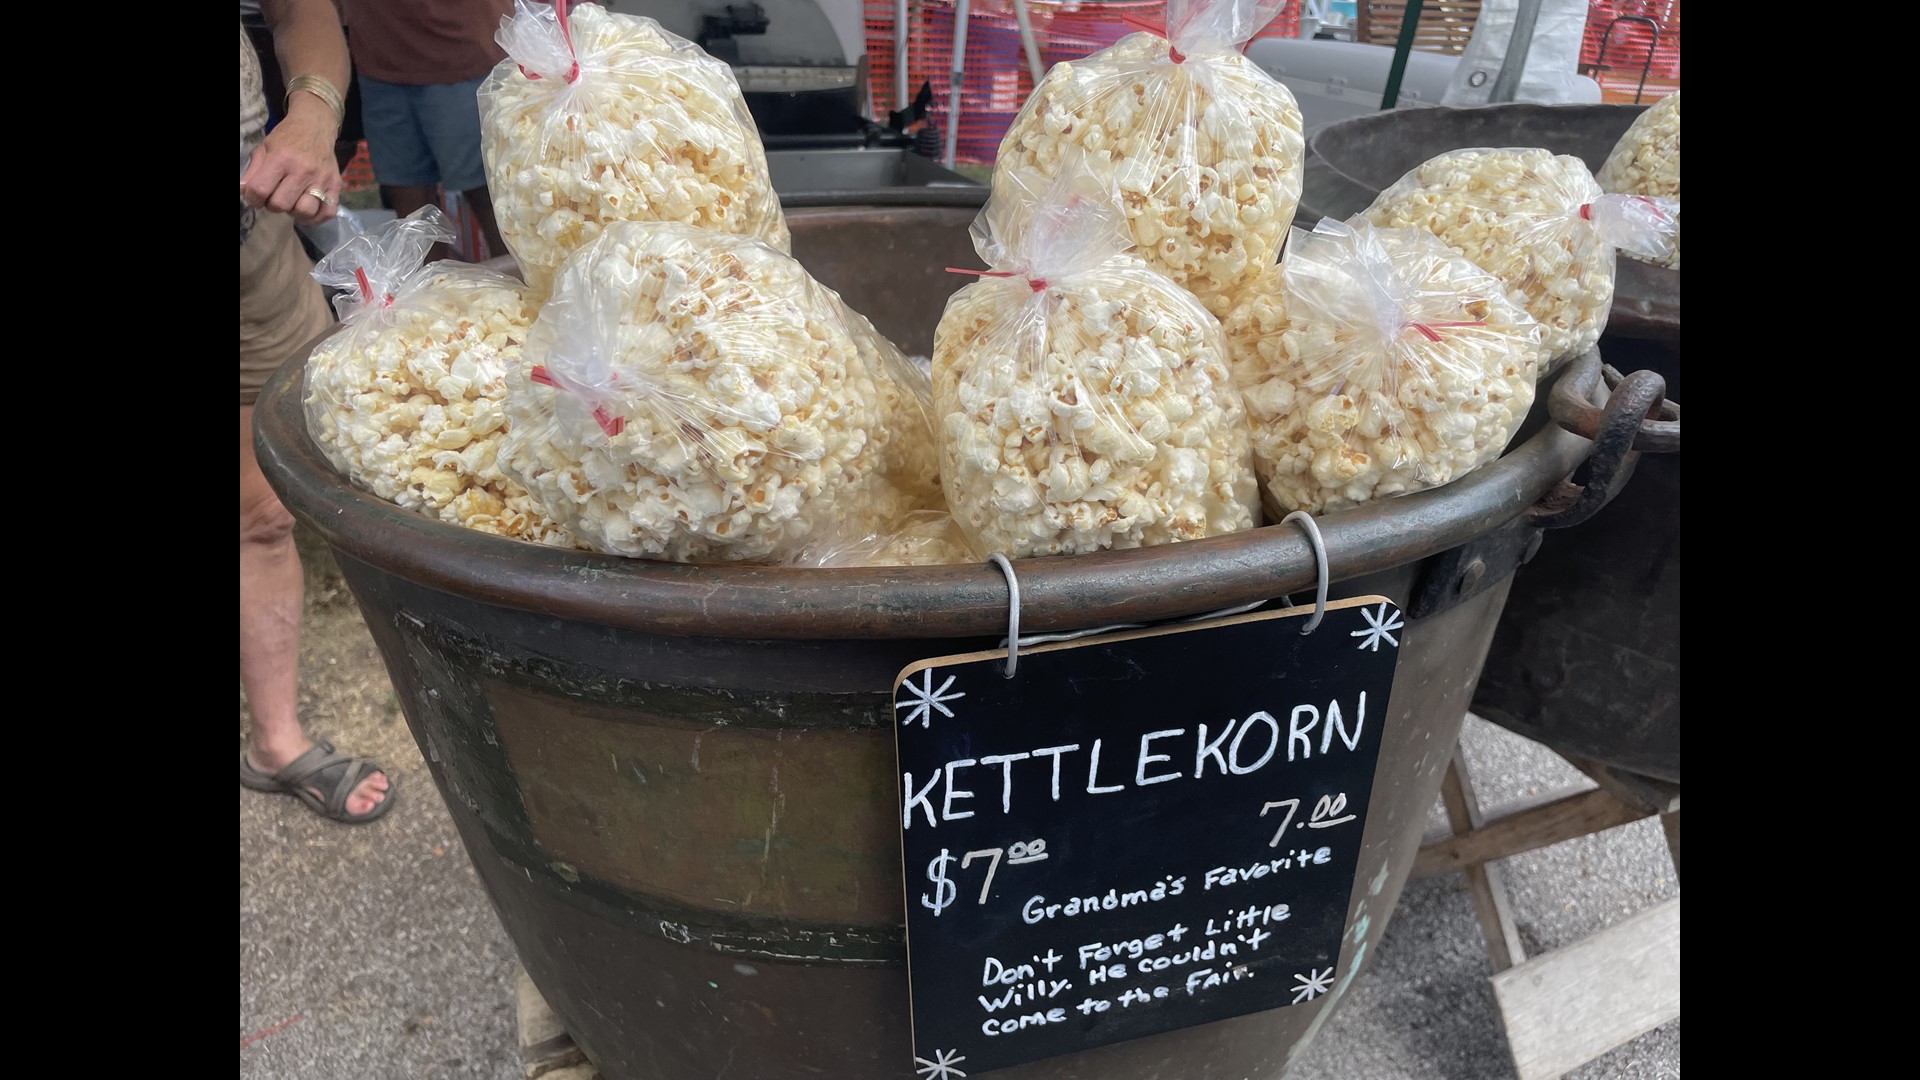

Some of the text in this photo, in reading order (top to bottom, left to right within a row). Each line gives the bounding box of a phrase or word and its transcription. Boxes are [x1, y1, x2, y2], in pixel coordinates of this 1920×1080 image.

[903, 691, 1367, 829] KETTLEKORN
[1204, 846, 1332, 890] Favorite
[983, 903, 1292, 987] Don't Forget Little
[1138, 928, 1272, 973] couldn't
[1076, 997, 1112, 1016] to
[1117, 985, 1170, 1009] the
